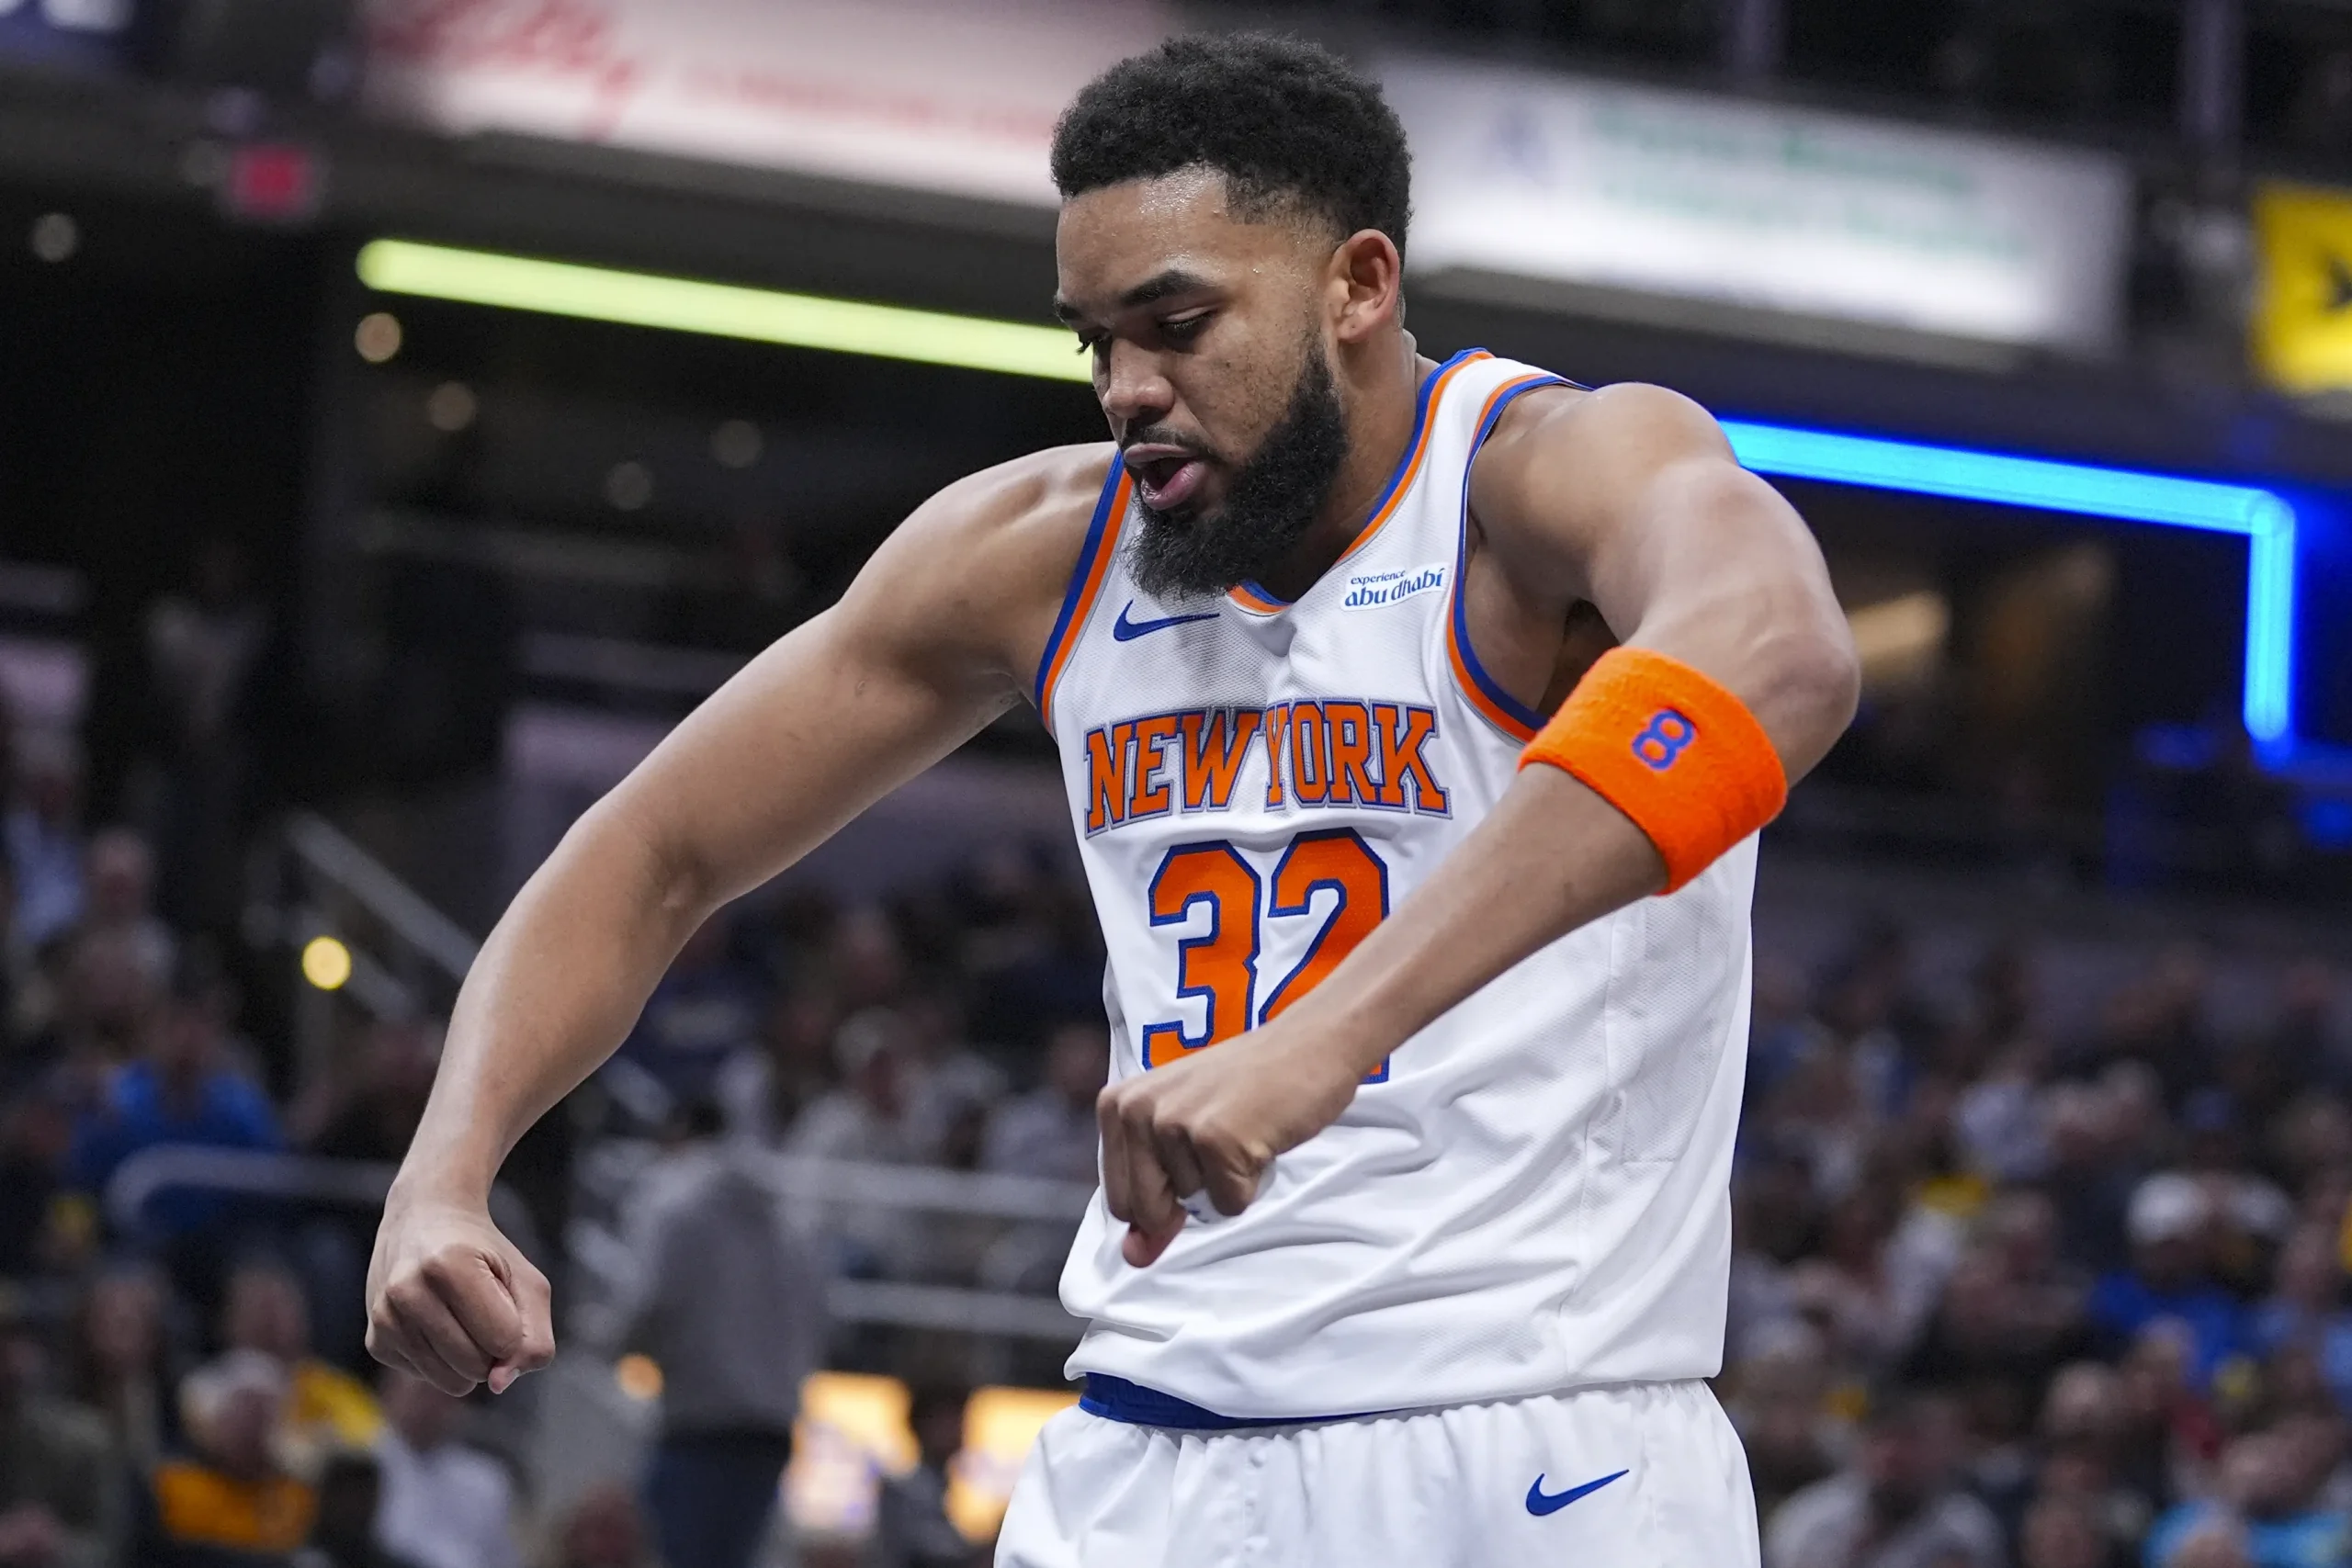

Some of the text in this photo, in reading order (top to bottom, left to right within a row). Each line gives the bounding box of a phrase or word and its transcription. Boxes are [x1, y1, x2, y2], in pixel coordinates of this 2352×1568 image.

[1345, 568, 1446, 606] abu dhabi
[1351, 570, 1406, 586] experience
[1084, 696, 1453, 839] NEW YORK
[1632, 709, 1695, 770] 8
[1142, 827, 1390, 1085] 32
